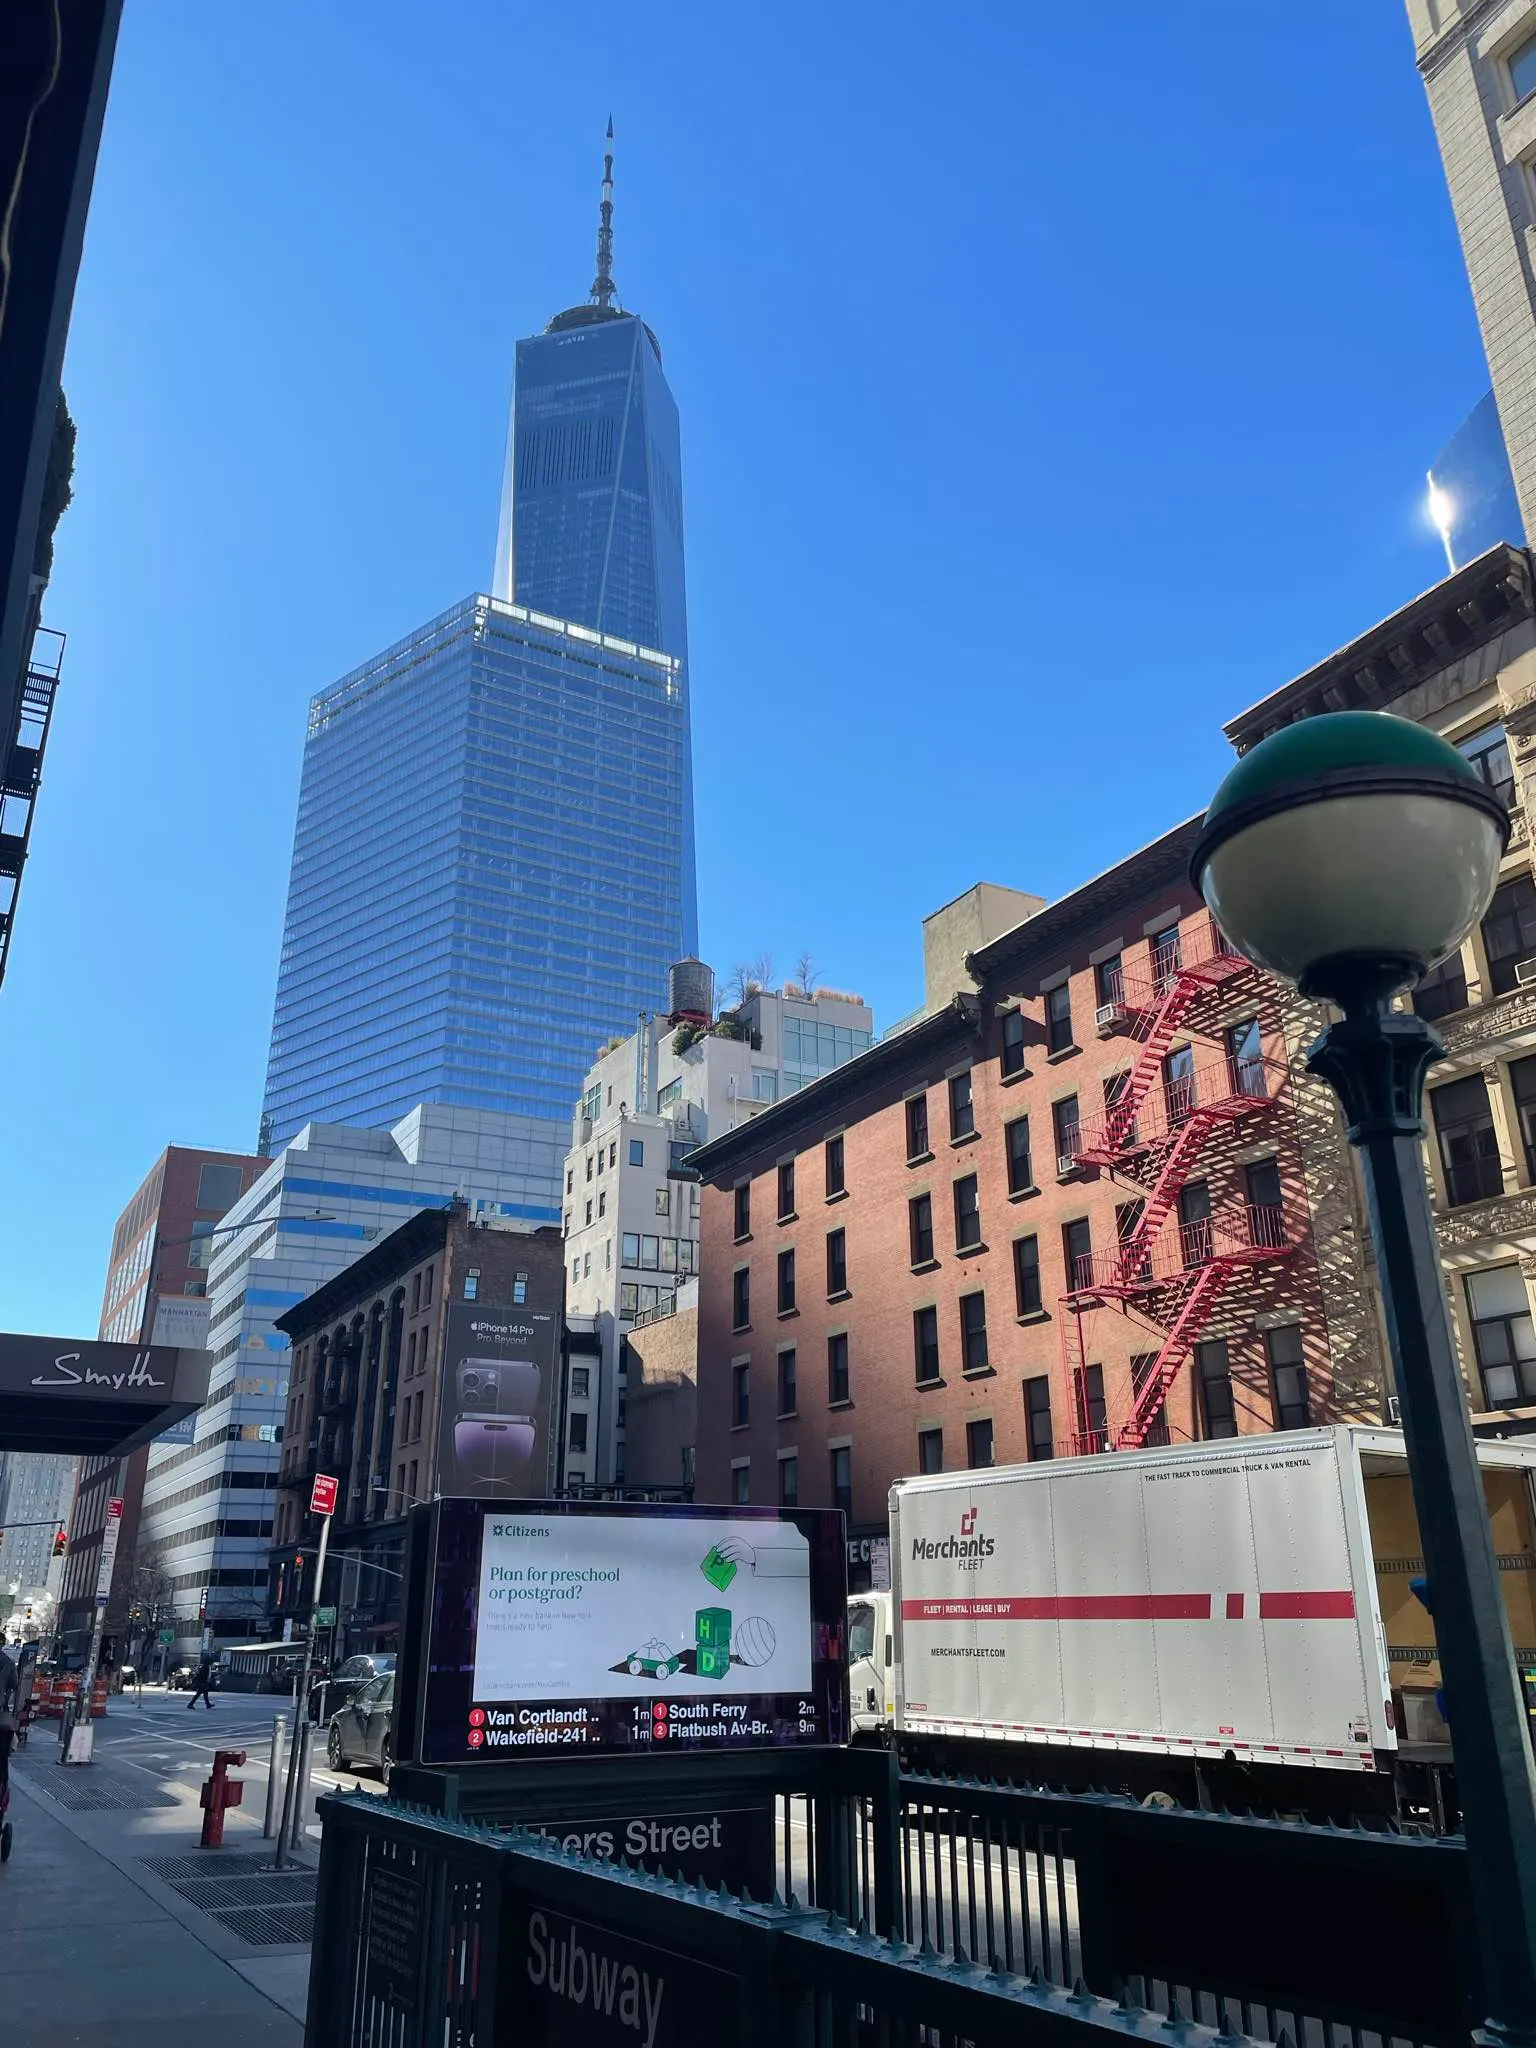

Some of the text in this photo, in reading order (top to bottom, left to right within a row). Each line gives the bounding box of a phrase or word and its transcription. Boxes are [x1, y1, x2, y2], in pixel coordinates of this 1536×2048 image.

[161, 1307, 207, 1318] MANHATTAN
[478, 1322, 534, 1335] iPhone 14 Pro
[31, 1351, 165, 1389] Smyth
[1157, 1473, 1171, 1481] FAST
[1172, 1471, 1191, 1480] TRACK
[1201, 1466, 1240, 1476] COMMERCIAL
[1242, 1465, 1263, 1473] TRUCK
[1271, 1462, 1284, 1470] VAN
[1285, 1459, 1311, 1468] RENTAL
[505, 1525, 550, 1537] Citizens
[912, 1533, 995, 1561] Merchants
[958, 1558, 984, 1571] FLEET
[490, 1567, 621, 1585] Plan for preschool
[488, 1585, 582, 1604] or postgrad?
[923, 1604, 1011, 1614] FLEET RENTAL LEASE BUY
[700, 1618, 710, 1639] H
[702, 1651, 715, 1672] D
[931, 1648, 1006, 1658] MERCHANTSFLEET.COM
[487, 1710, 515, 1726] Van
[519, 1707, 588, 1726] Cortlandt
[632, 1706, 650, 1721] 1m
[669, 1703, 709, 1719] South
[712, 1703, 747, 1720] Ferry
[798, 1701, 815, 1715] 2m
[486, 1727, 587, 1746] Wakefield-241
[632, 1726, 650, 1740] 1m
[669, 1722, 727, 1739] Flatbush
[730, 1721, 773, 1736] Av-Br..
[799, 1719, 815, 1733] 9m
[625, 1817, 722, 1856] Street
[527, 1911, 664, 2048] Subway
